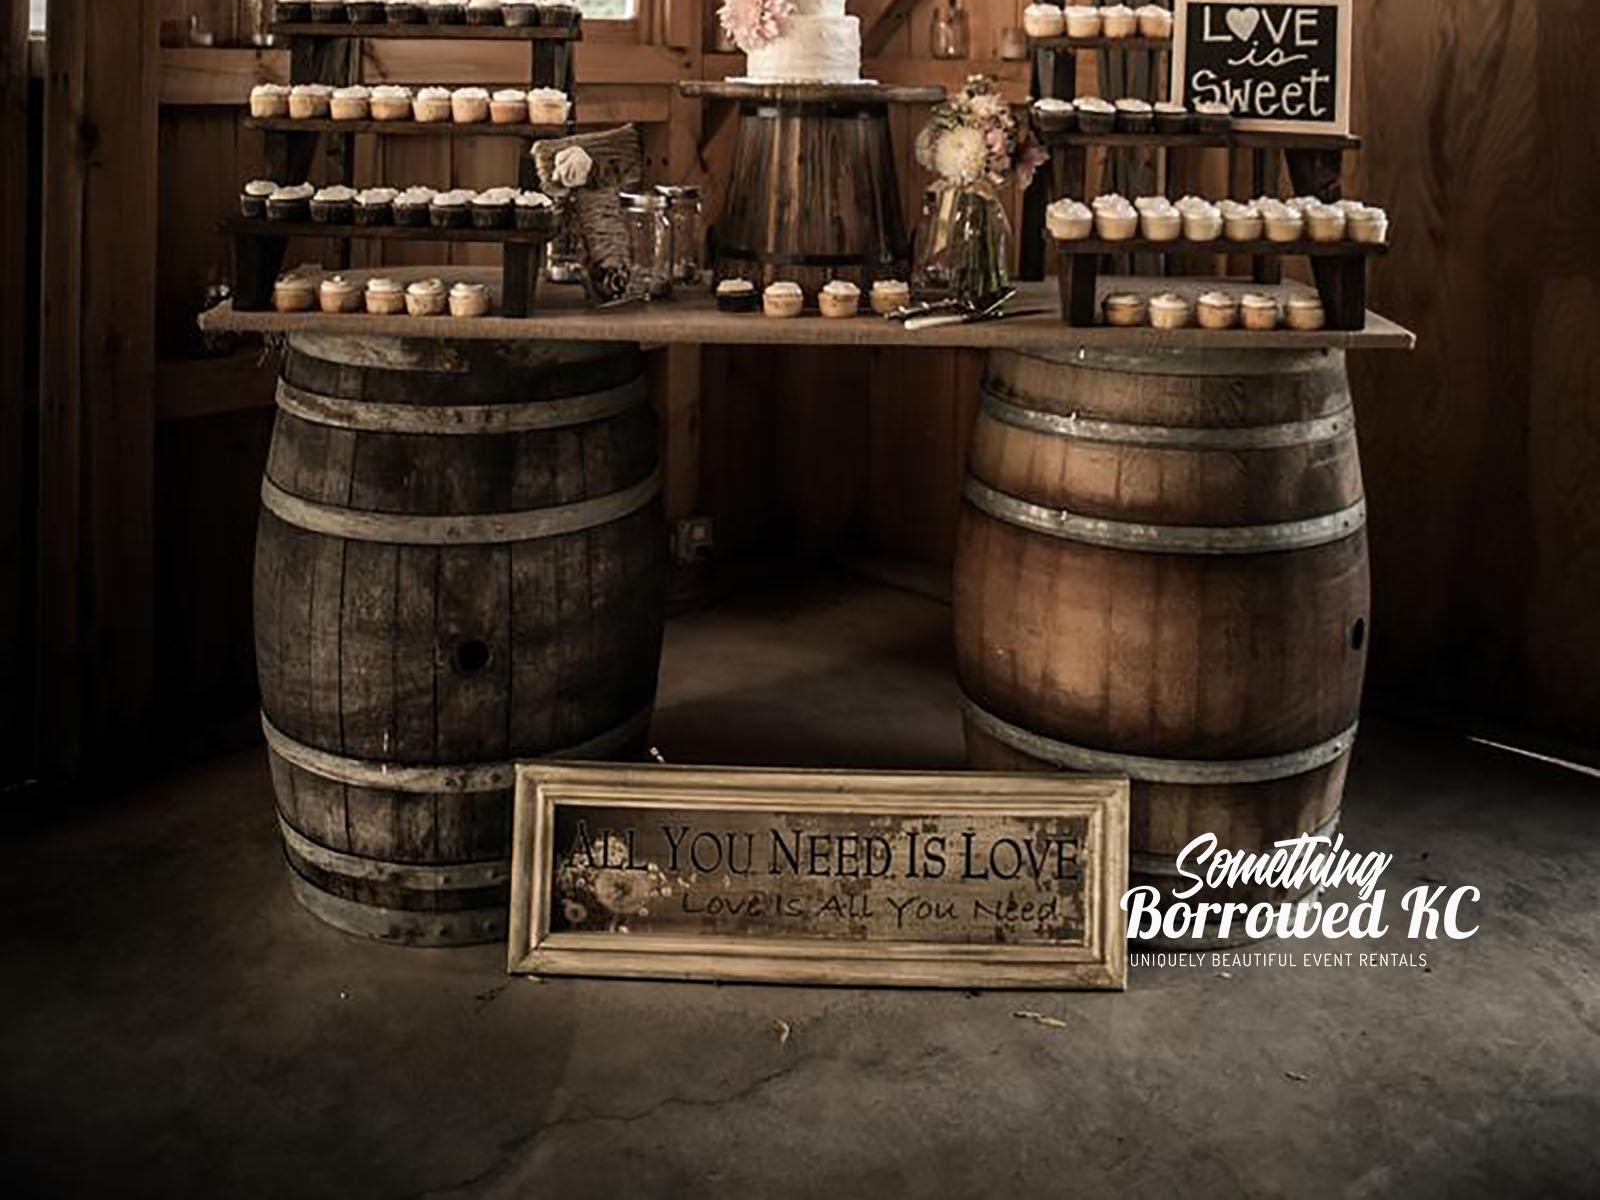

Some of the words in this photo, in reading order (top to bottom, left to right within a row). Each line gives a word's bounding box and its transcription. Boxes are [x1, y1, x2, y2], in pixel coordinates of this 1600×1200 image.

[1228, 40, 1309, 67] is
[564, 818, 650, 871] ALL
[662, 826, 751, 875] YOU
[768, 828, 893, 878] NEED
[905, 831, 946, 879] IS
[961, 832, 1080, 881] LOVE
[682, 892, 763, 918] Love
[773, 895, 804, 918] Is
[815, 895, 873, 919] All
[887, 896, 959, 929] You
[972, 898, 1059, 923] Need
